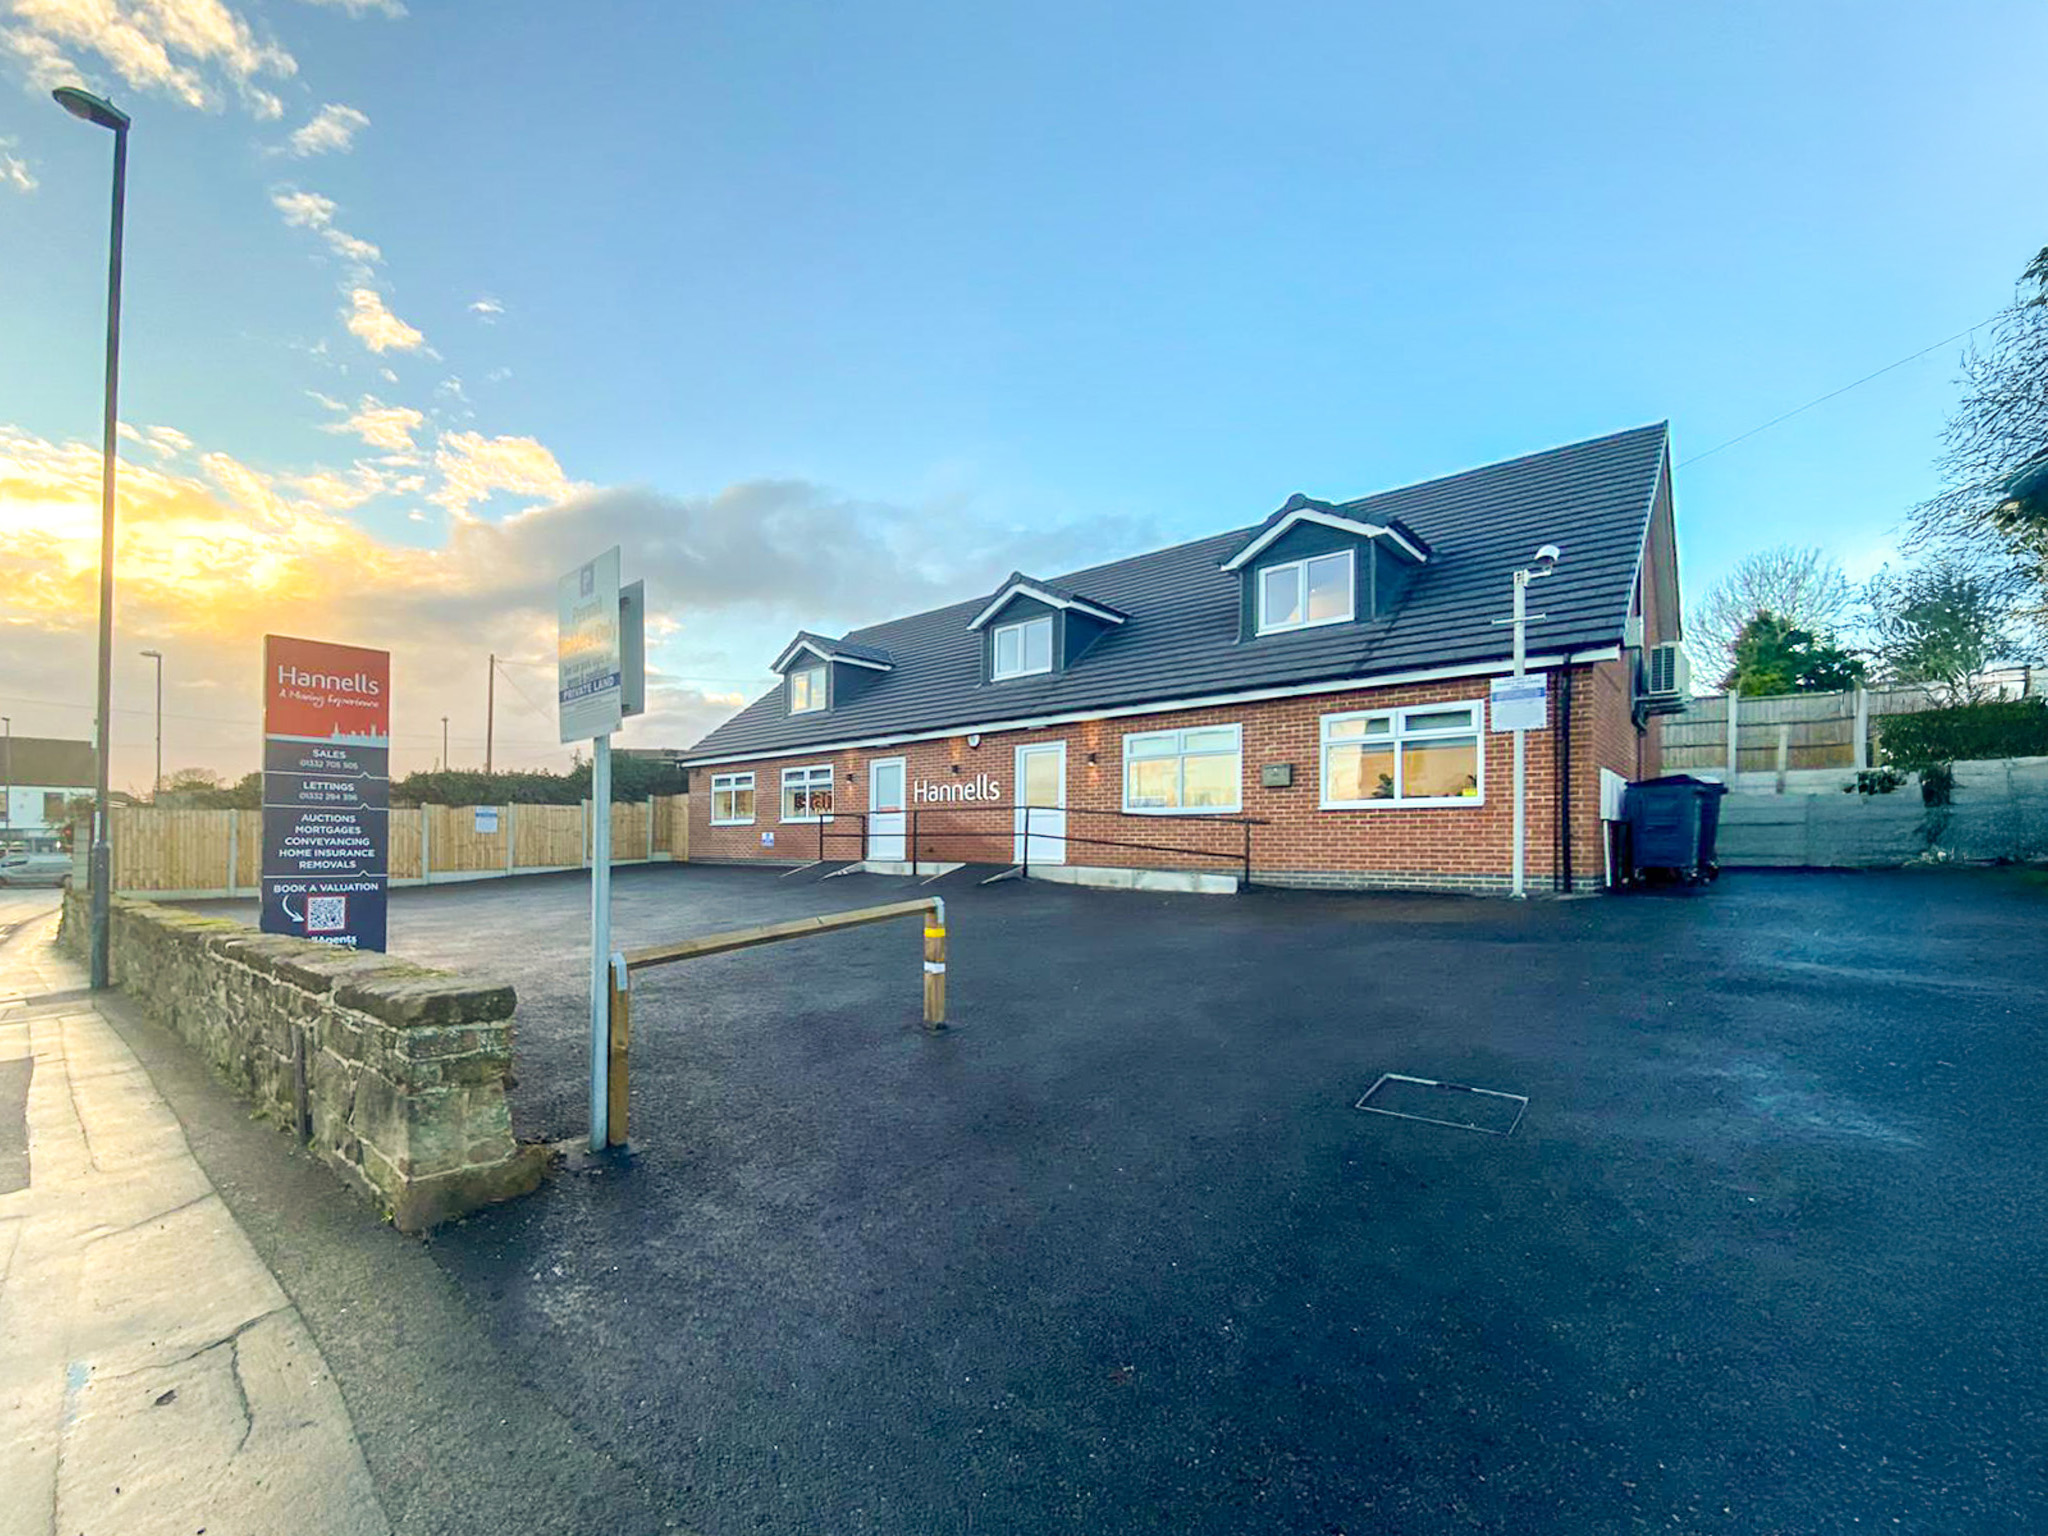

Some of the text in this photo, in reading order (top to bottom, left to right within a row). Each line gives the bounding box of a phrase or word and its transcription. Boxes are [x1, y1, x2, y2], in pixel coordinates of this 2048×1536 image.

[278, 665, 380, 695] Hannells
[312, 749, 347, 759] SALES
[303, 781, 355, 792] LETTINGS
[913, 773, 1001, 803] Hannells
[301, 814, 357, 823] AUCTIONS
[295, 825, 361, 835] MORTGAGES
[284, 837, 370, 846] CONVEYANCING
[279, 849, 375, 858] HOME INSURANCE
[299, 861, 357, 870] REMOVALS
[274, 882, 379, 893] BOOK A VALUATION
